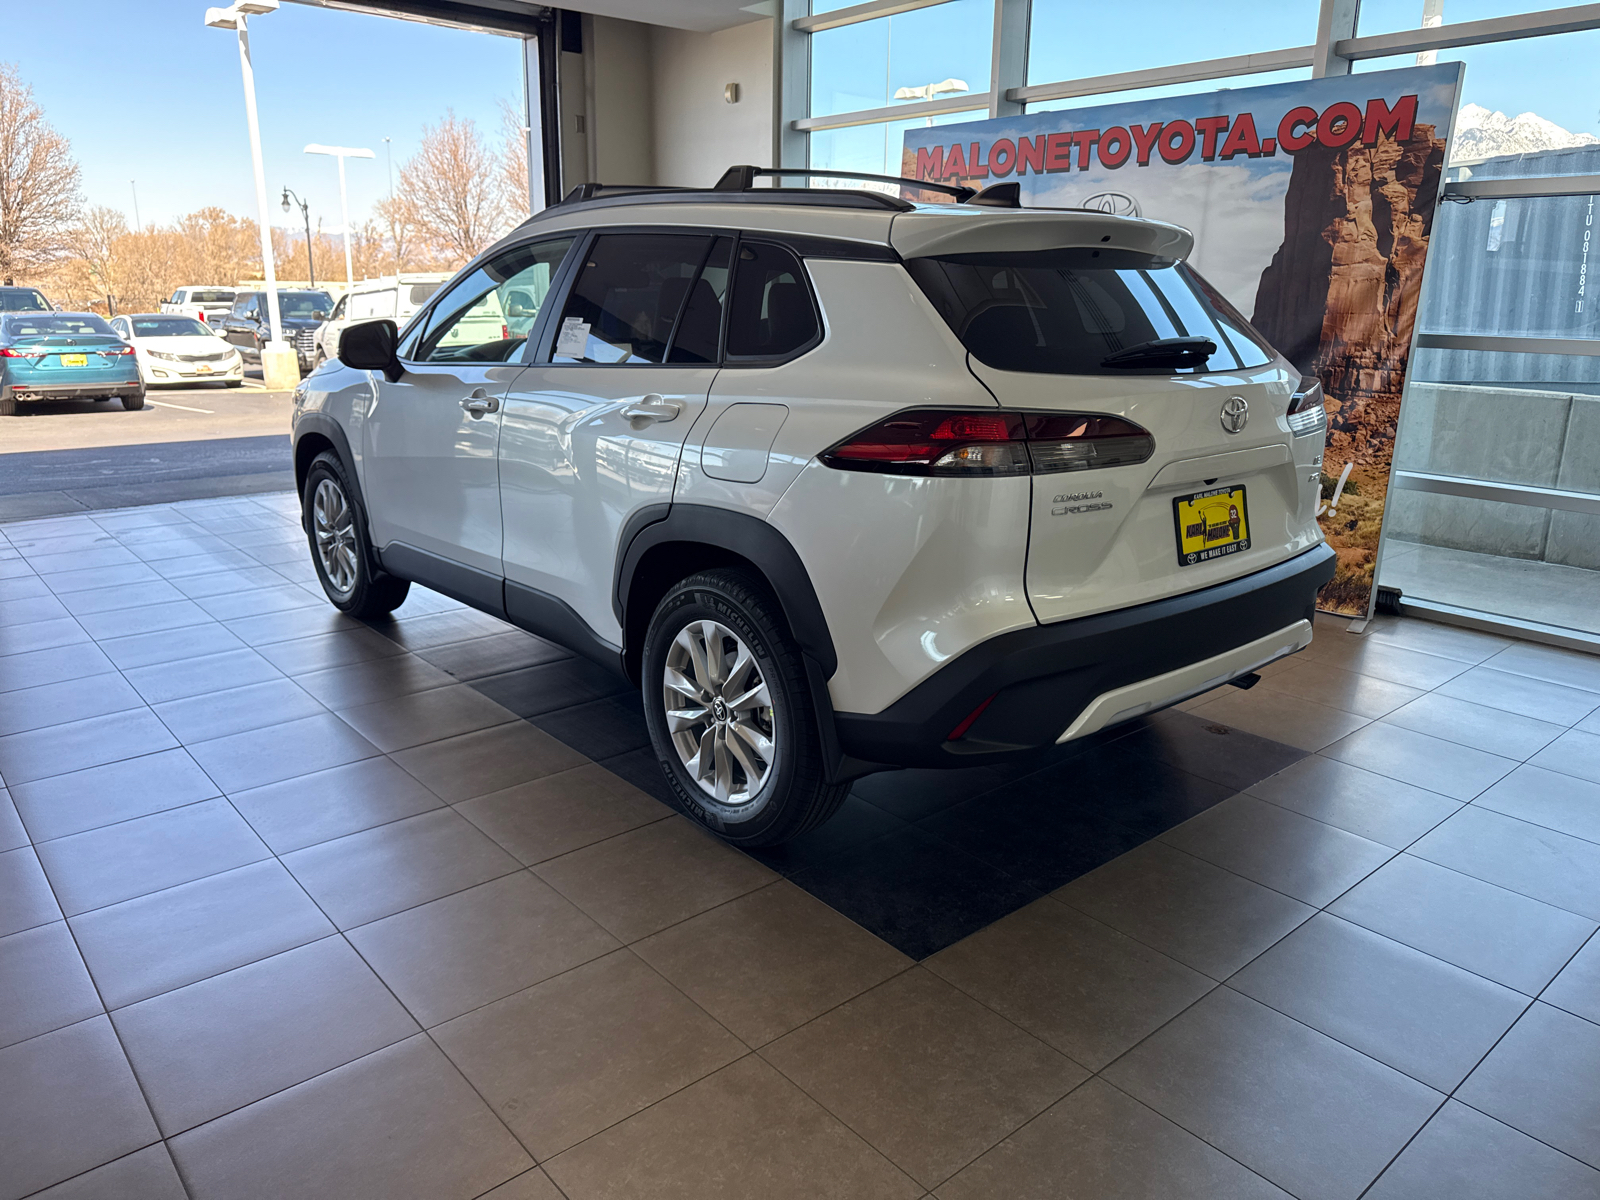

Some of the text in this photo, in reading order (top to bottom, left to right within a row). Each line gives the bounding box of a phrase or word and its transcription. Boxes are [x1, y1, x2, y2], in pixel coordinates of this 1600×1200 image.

[916, 95, 1418, 180] MALONETOYOTA.COM
[1051, 502, 1113, 515] CROSS
[1053, 490, 1103, 503] COROLLA
[1200, 552, 1208, 560] WE
[1209, 548, 1221, 557] MAKE
[1227, 544, 1237, 552] EASY
[717, 603, 765, 657] MICHELIN
[662, 763, 705, 818] MICHELIN
